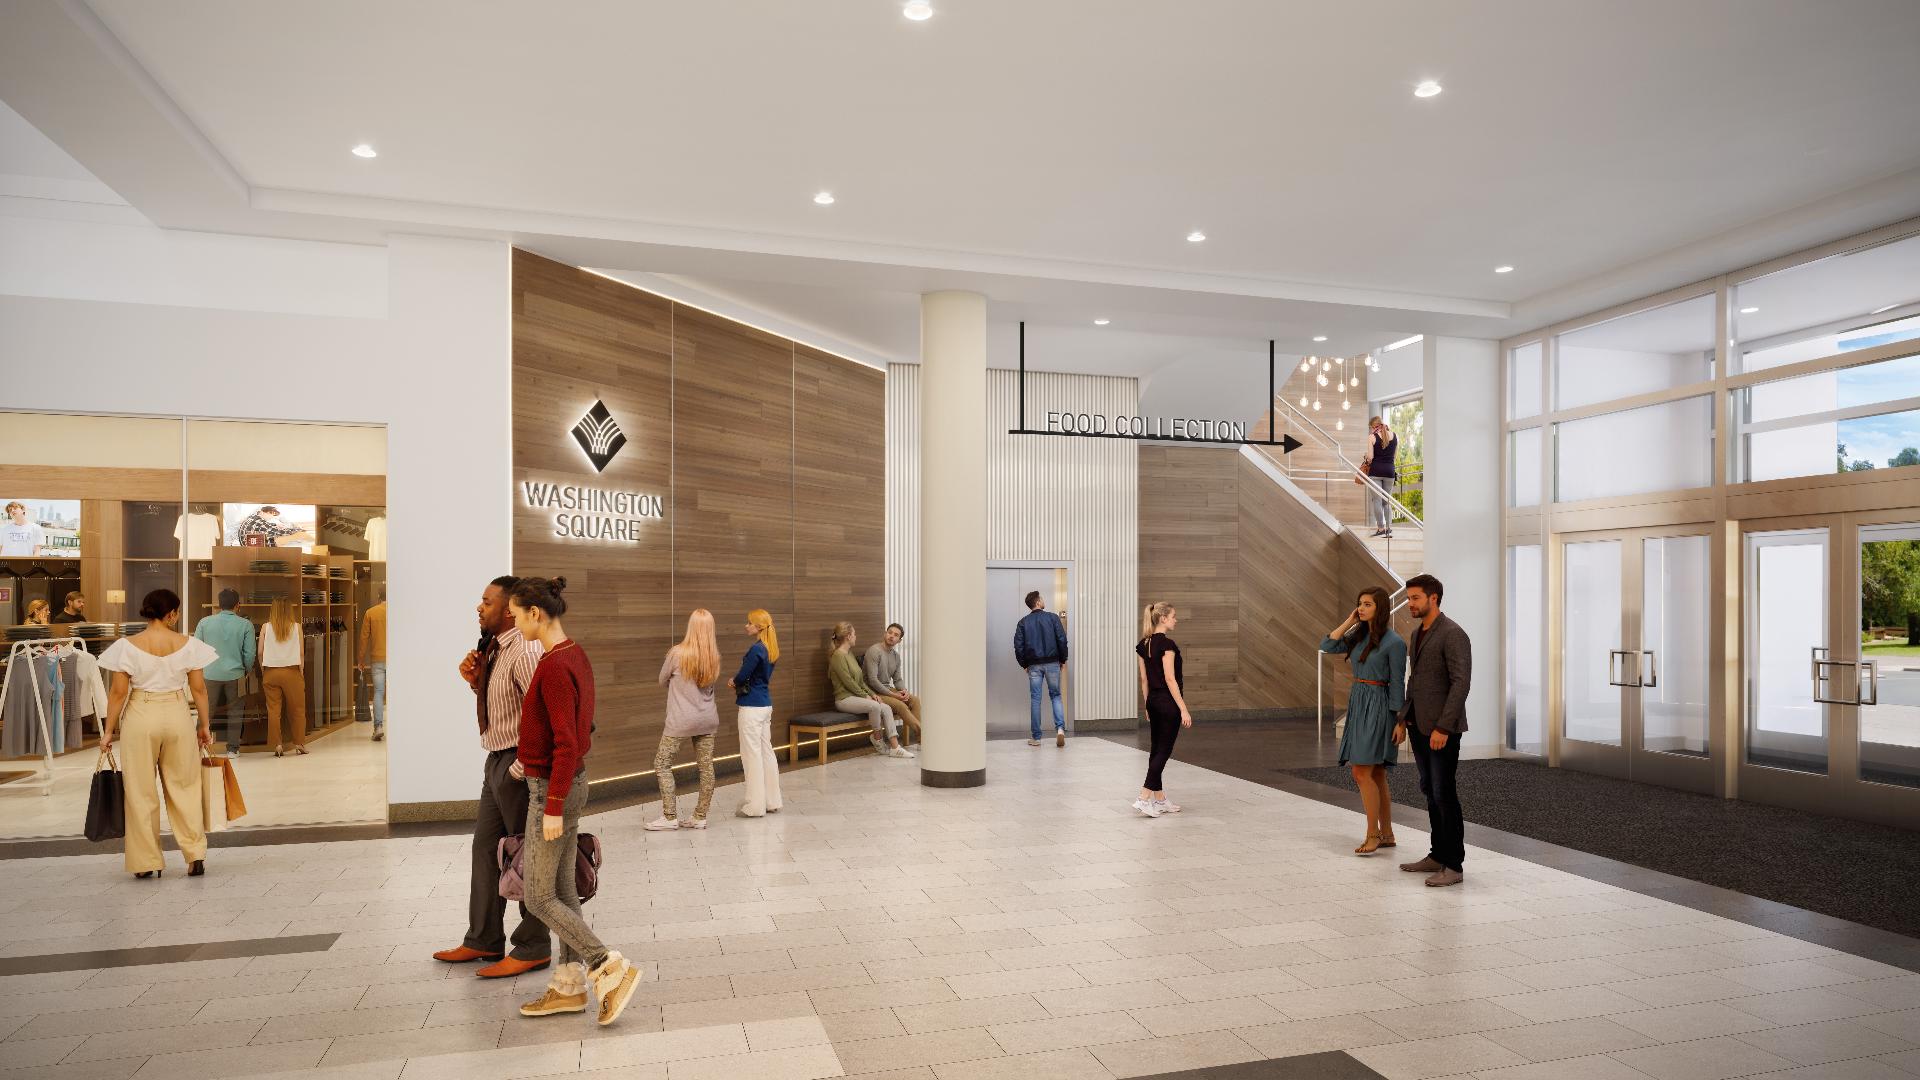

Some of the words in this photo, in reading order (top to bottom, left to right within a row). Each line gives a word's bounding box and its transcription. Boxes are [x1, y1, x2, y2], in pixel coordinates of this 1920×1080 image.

[1047, 411, 1106, 434] FOOD
[1115, 416, 1246, 441] COLLECTION
[524, 481, 664, 518] WASHINGTON
[556, 513, 641, 541] SQUARE
